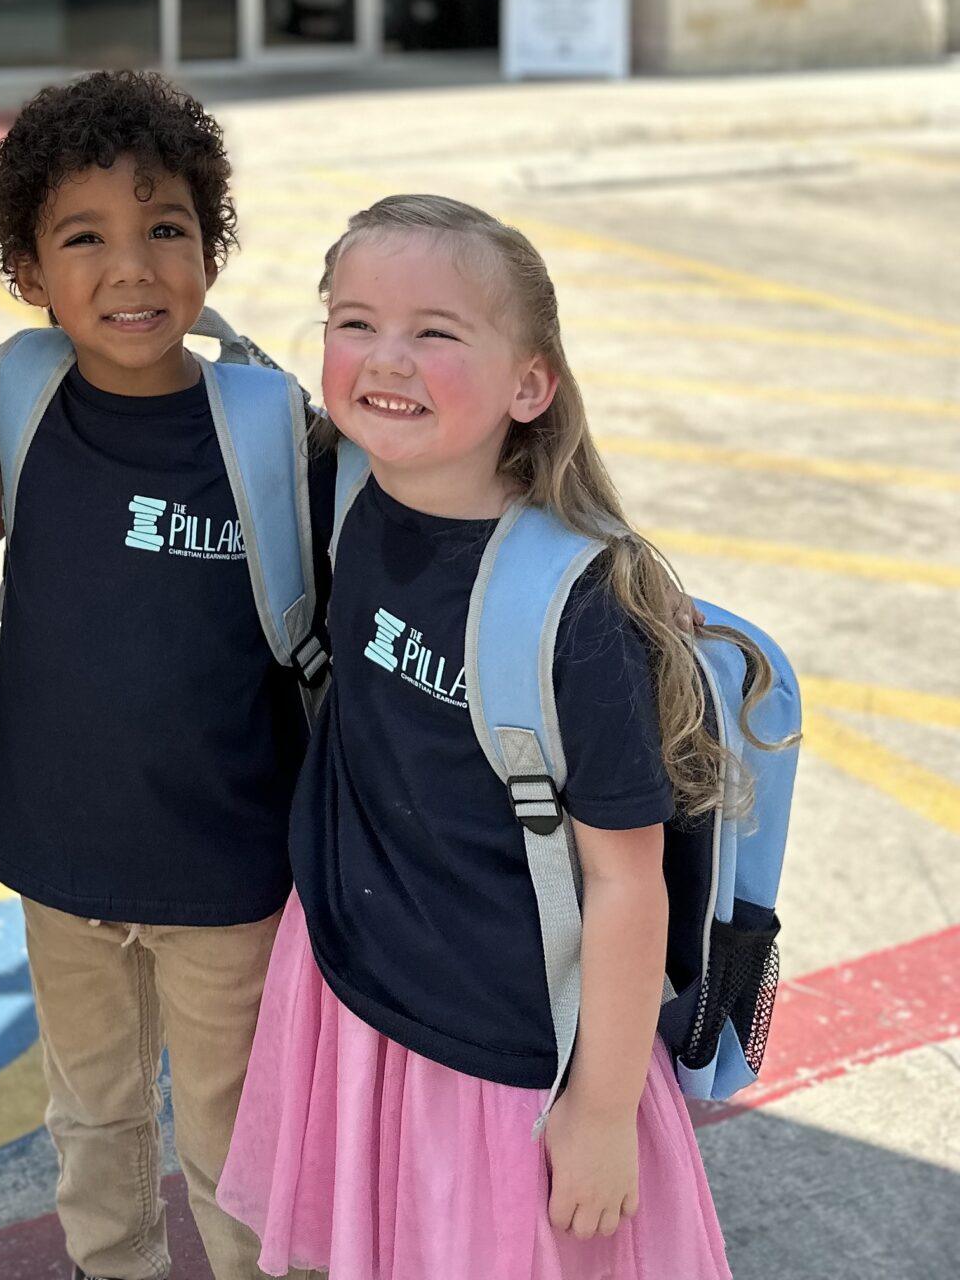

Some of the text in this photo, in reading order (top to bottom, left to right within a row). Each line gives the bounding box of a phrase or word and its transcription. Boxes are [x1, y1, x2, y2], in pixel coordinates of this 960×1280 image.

[173, 503, 187, 514] THE
[169, 514, 246, 552] PILLAR
[169, 549, 201, 558] CHRISTIAN
[410, 627, 424, 644] THE
[401, 638, 468, 701] PILLA
[400, 672, 468, 709] CHRISTIAN LEARNING
